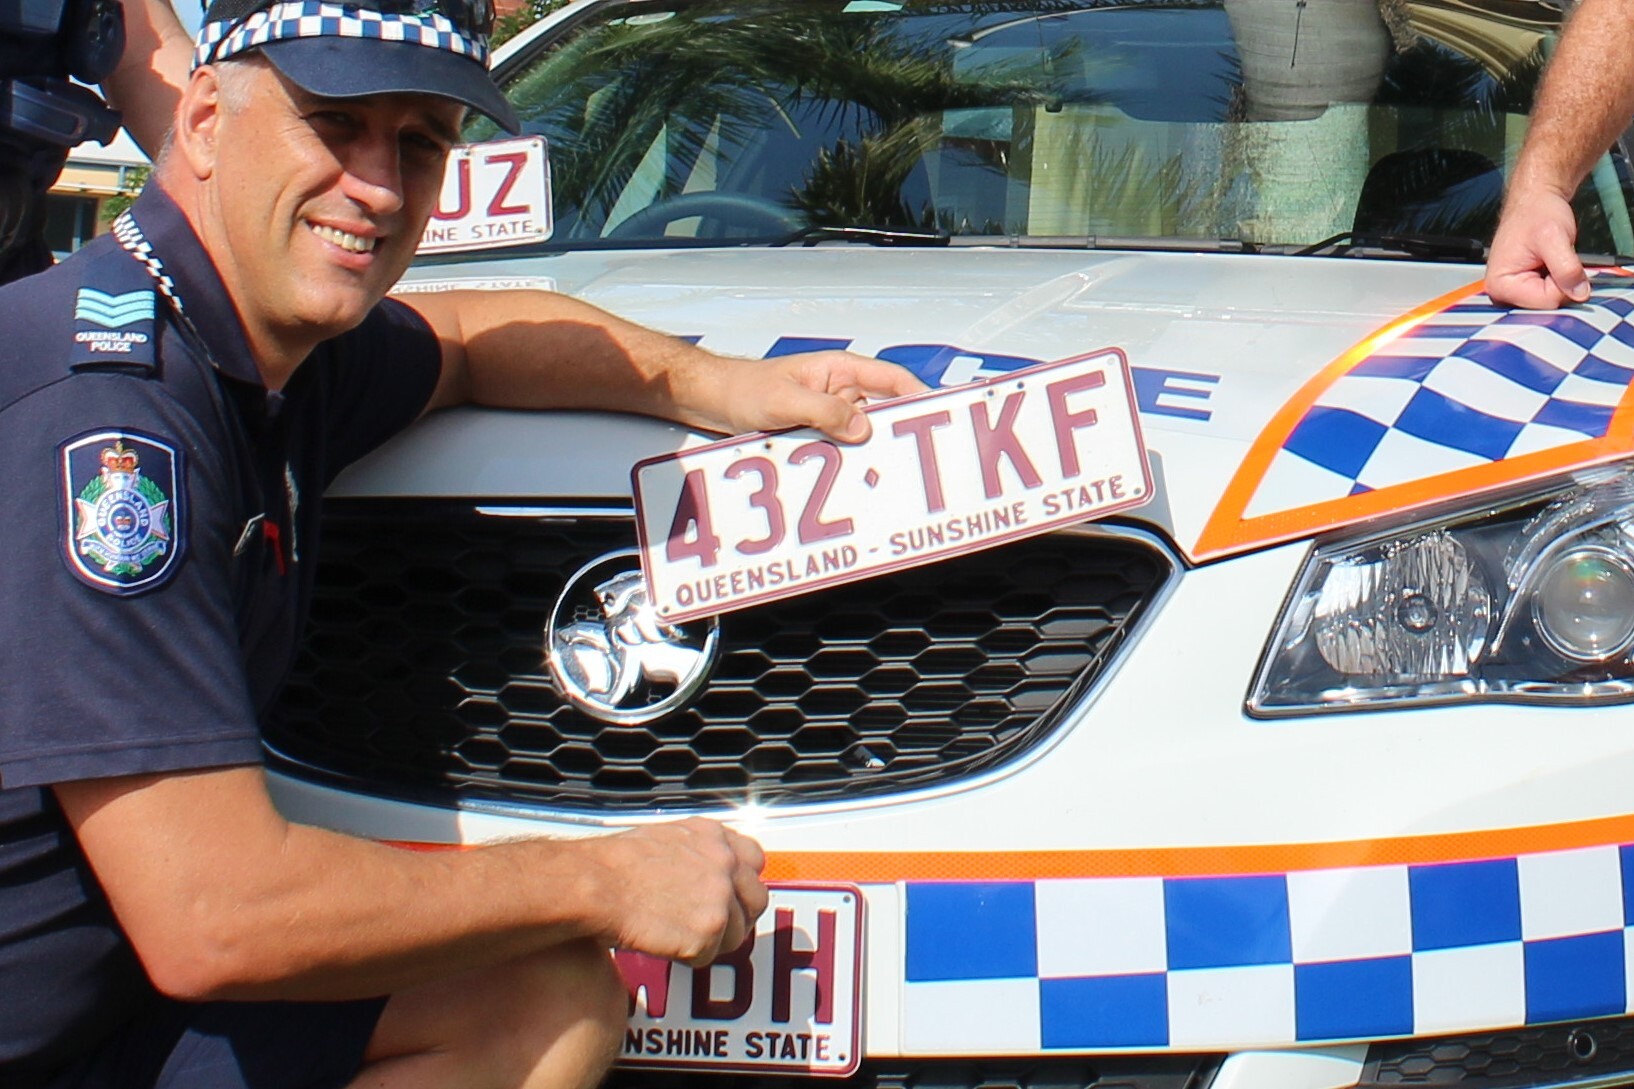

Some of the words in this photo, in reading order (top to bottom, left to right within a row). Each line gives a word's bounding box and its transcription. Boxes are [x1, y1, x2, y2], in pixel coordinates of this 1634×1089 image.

[430, 151, 531, 221] UZ
[421, 227, 458, 243] INE
[471, 220, 533, 239] STATE
[75, 332, 148, 343] QUEENSLAND
[89, 341, 132, 352] POLICE
[676, 545, 857, 607] QUEENSLAND
[889, 501, 1028, 555] SUNSHINE
[1042, 475, 1126, 516] STATE
[613, 906, 836, 1024] WBH
[625, 1027, 729, 1057] NSHINE
[745, 1031, 830, 1061] STATE
